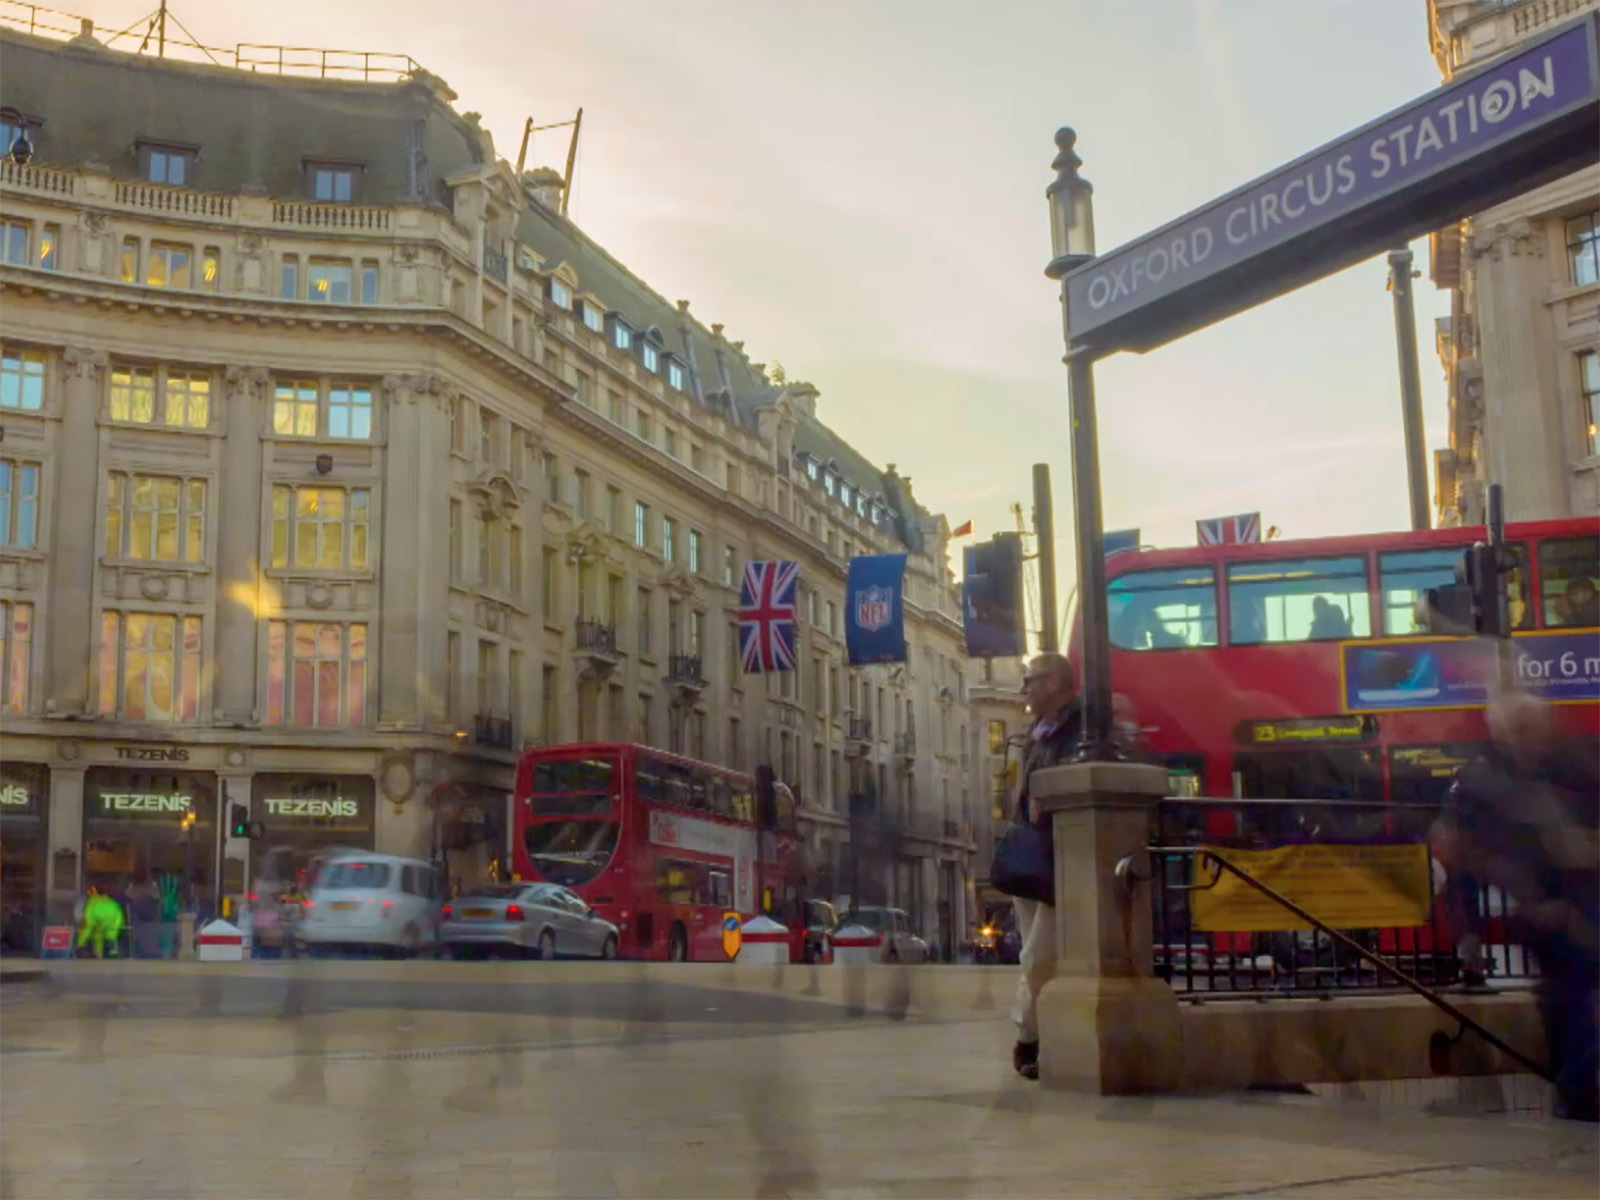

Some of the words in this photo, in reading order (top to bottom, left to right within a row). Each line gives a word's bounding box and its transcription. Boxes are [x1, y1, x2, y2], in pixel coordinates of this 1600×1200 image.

[1086, 226, 1214, 311] OXFORD
[1224, 154, 1357, 246] CIRCUS
[1369, 56, 1555, 179] STATION
[860, 603, 887, 625] NFL
[1517, 653, 1554, 678] for
[1560, 651, 1578, 677] 6
